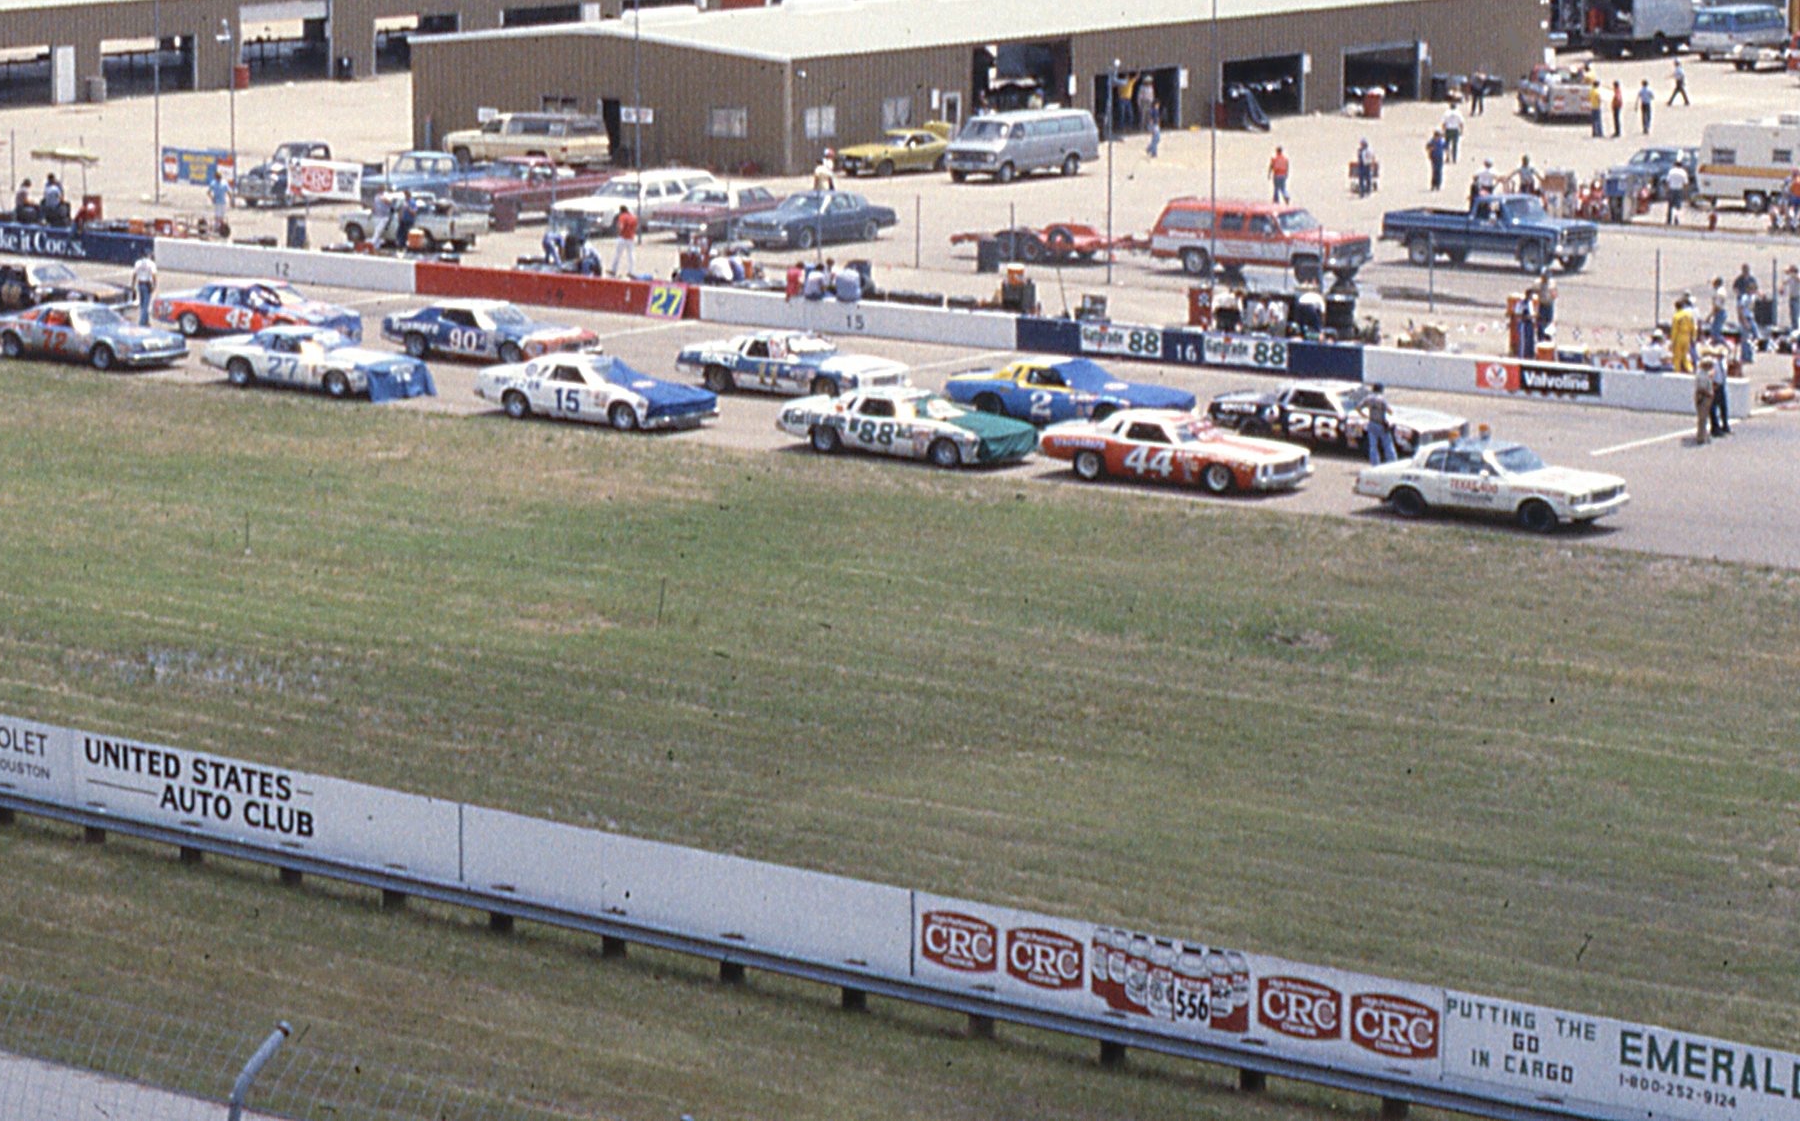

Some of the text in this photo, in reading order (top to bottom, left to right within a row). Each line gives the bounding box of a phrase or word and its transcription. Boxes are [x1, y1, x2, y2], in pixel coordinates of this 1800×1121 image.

[19, 229, 30, 252] it
[275, 263, 290, 277] 12
[650, 287, 683, 315] 27
[225, 309, 253, 329] 43
[846, 314, 865, 330] 15
[41, 329, 68, 353] 72
[449, 328, 478, 351] 90
[1127, 330, 1159, 354] 88
[1175, 343, 1197, 362] 16
[1253, 341, 1285, 365] 88
[266, 356, 298, 379] 27
[1522, 370, 1590, 391] Valvoline
[555, 387, 580, 413] 15
[1030, 390, 1053, 415] 2
[859, 419, 895, 445] 88
[1287, 412, 1338, 438] 28
[1124, 446, 1173, 476] 44
[84, 737, 292, 801] UNITED STATES
[160, 784, 315, 838] AUTO CLUB
[924, 922, 994, 964] CRC
[1010, 939, 1079, 981] CRC
[1262, 987, 1337, 1030] CRC
[1446, 998, 1597, 1042] PUTTING THE
[1354, 1007, 1434, 1049] CRC
[1512, 1032, 1540, 1054] GO
[1471, 1048, 1574, 1084] IN CARGO
[1618, 1072, 1738, 1110] 1-800-252-9124
